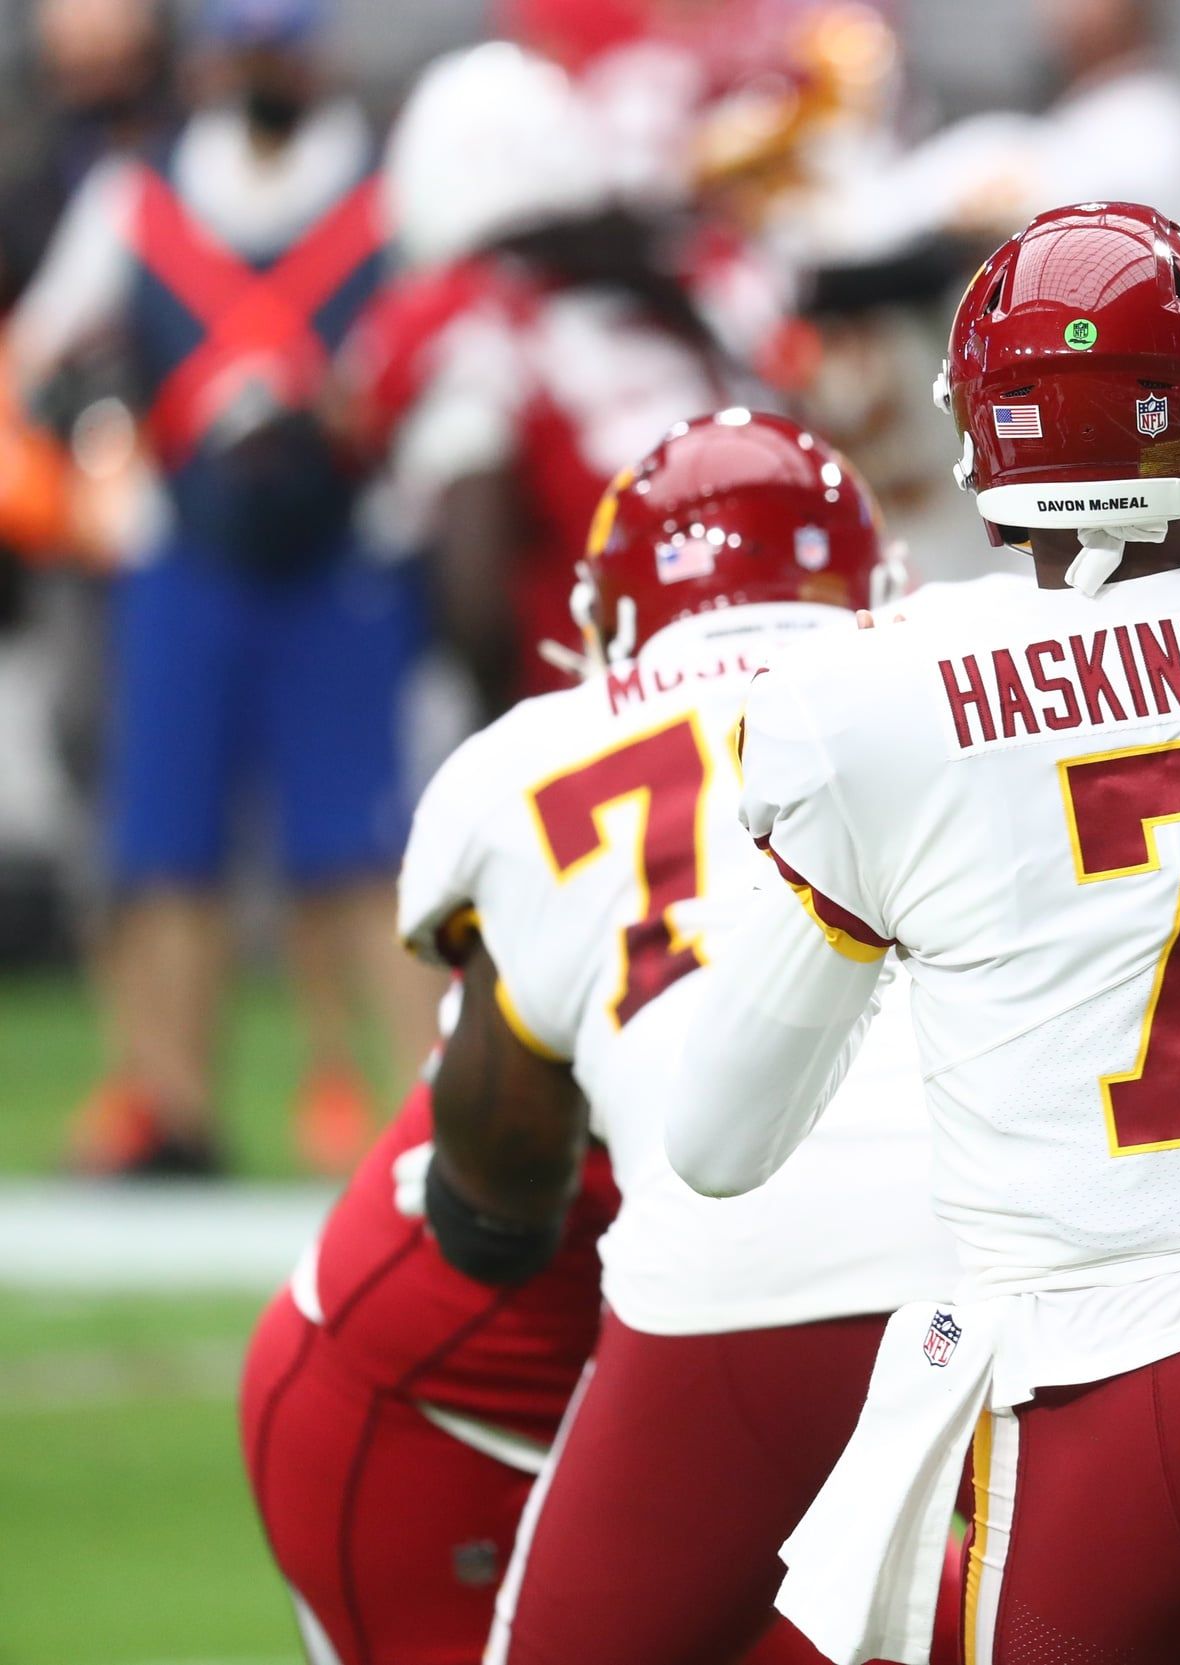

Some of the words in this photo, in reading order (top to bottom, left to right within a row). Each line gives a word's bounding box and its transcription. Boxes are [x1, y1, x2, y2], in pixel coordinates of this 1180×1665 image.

[1141, 413, 1164, 431] NFL
[1037, 499, 1085, 512] DAVON
[1089, 496, 1148, 511] McNEAL
[923, 1328, 951, 1364] NFL
